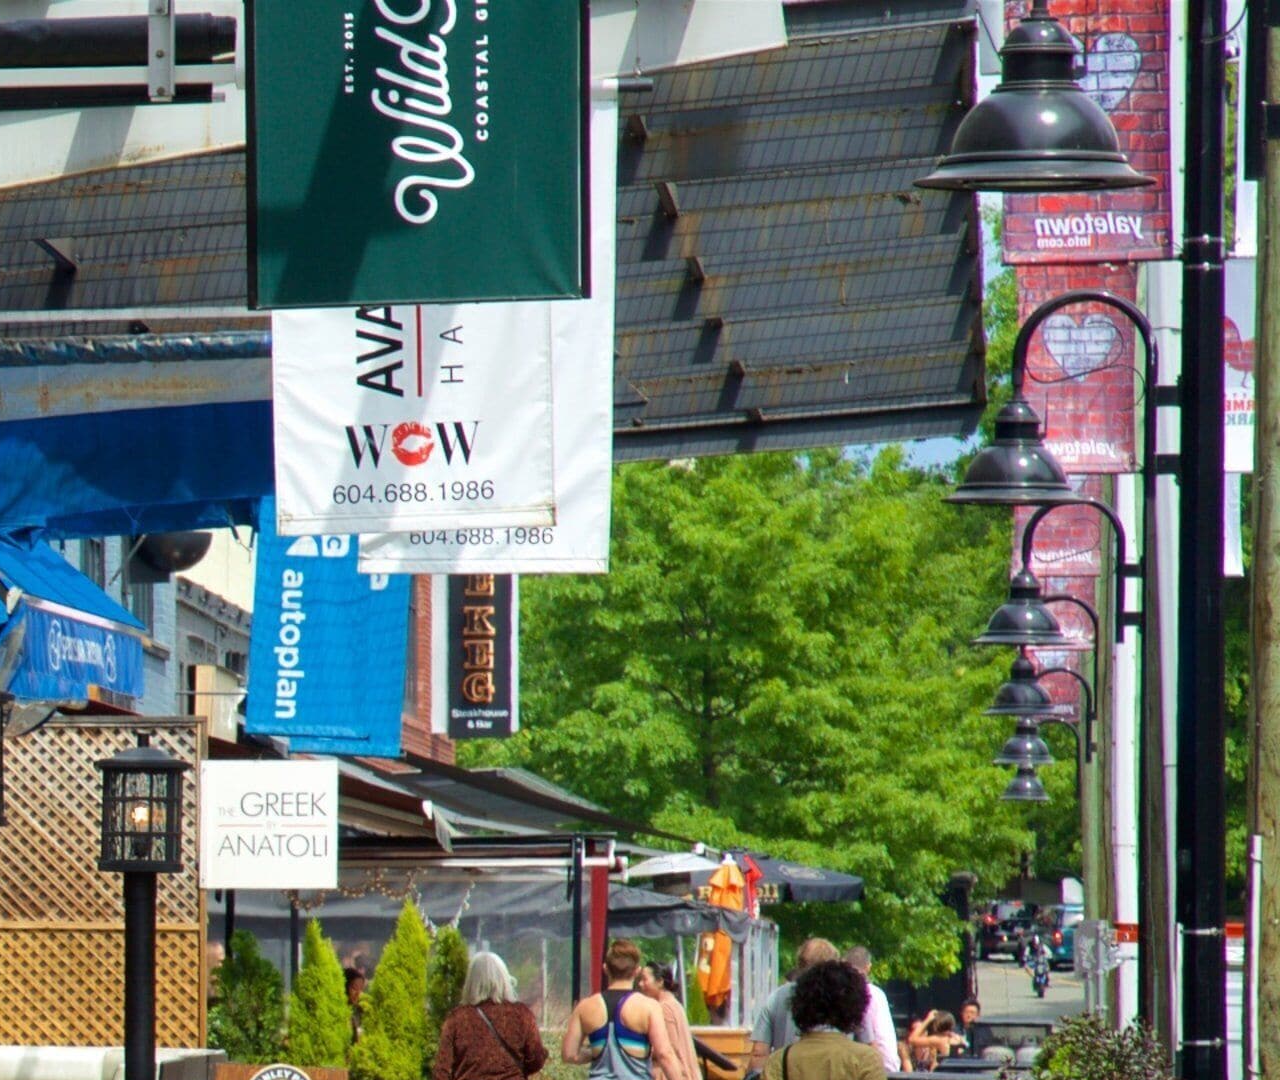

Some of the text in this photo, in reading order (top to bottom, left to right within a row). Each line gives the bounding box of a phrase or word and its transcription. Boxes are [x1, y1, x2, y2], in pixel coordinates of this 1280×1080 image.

[344, 12, 354, 93] EST. 2015
[475, 34, 489, 141] COASTAL
[371, 26, 475, 224] Wild
[356, 305, 404, 398] AVA
[440, 325, 464, 384] HA
[332, 480, 495, 504] 604.688.1986
[409, 527, 554, 546] 604.688.1986
[273, 568, 307, 719] autoplan
[462, 606, 496, 703] KEG
[240, 791, 327, 817] GREEK
[217, 834, 328, 857] ANATOLI
